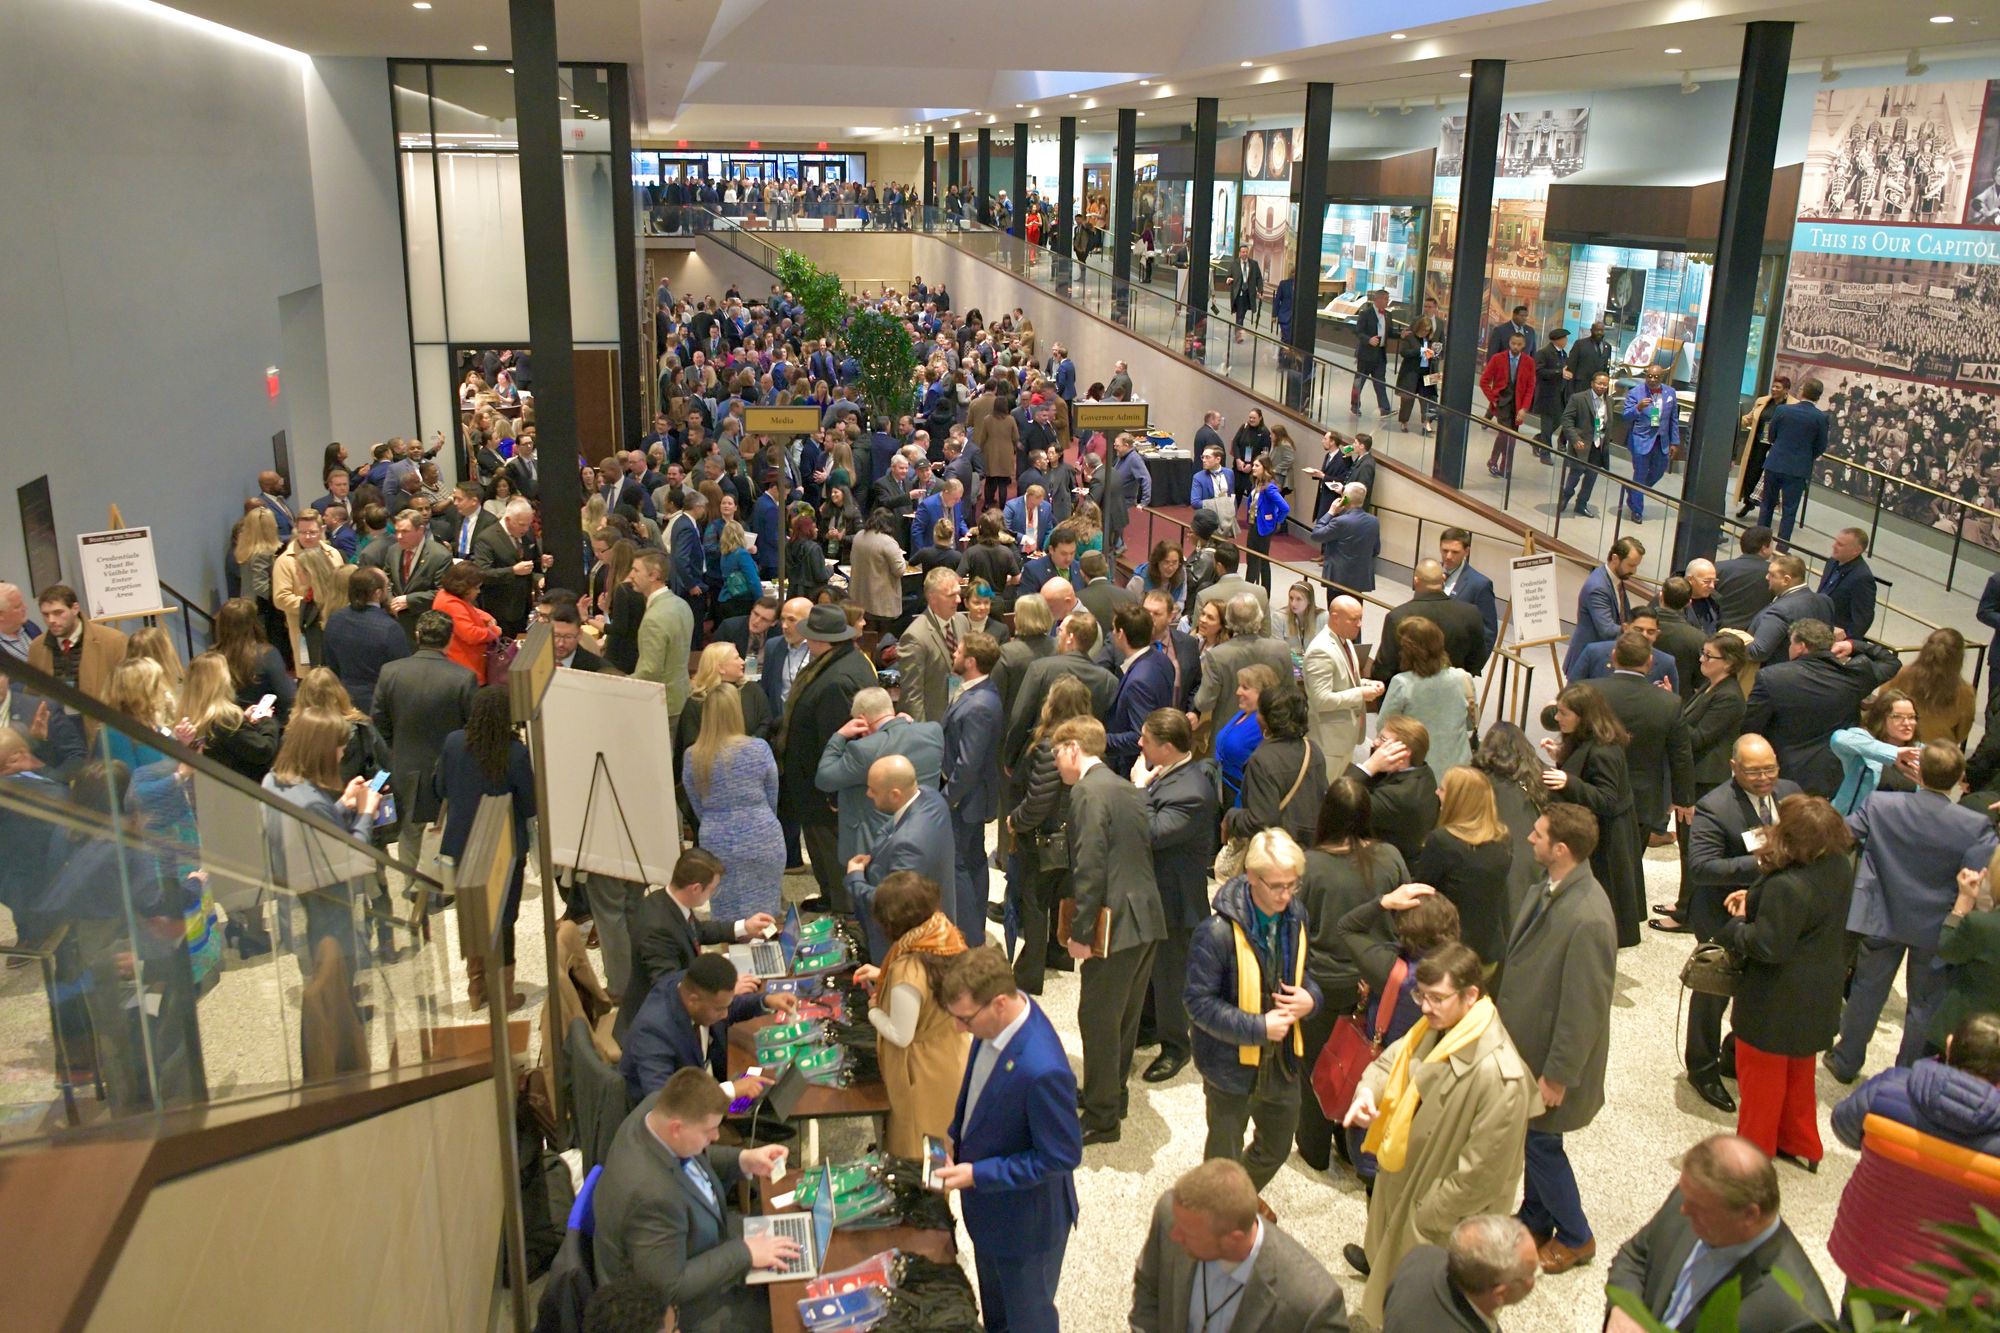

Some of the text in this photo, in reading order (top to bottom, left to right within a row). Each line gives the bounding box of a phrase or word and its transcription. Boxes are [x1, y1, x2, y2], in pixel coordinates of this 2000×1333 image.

[1810, 228, 2000, 259] THIS IS OUR CAPITOL
[1498, 268, 1508, 277] THE
[1510, 269, 1532, 280] SENATE
[1959, 363, 2000, 380] LAN
[770, 416, 794, 425] Media
[1080, 414, 1115, 422] Governor
[96, 552, 139, 563] Credentials
[103, 569, 128, 577] Visible
[105, 583, 141, 592] Reception
[1520, 579, 1547, 588] Credentials
[1524, 610, 1547, 618] Reception
